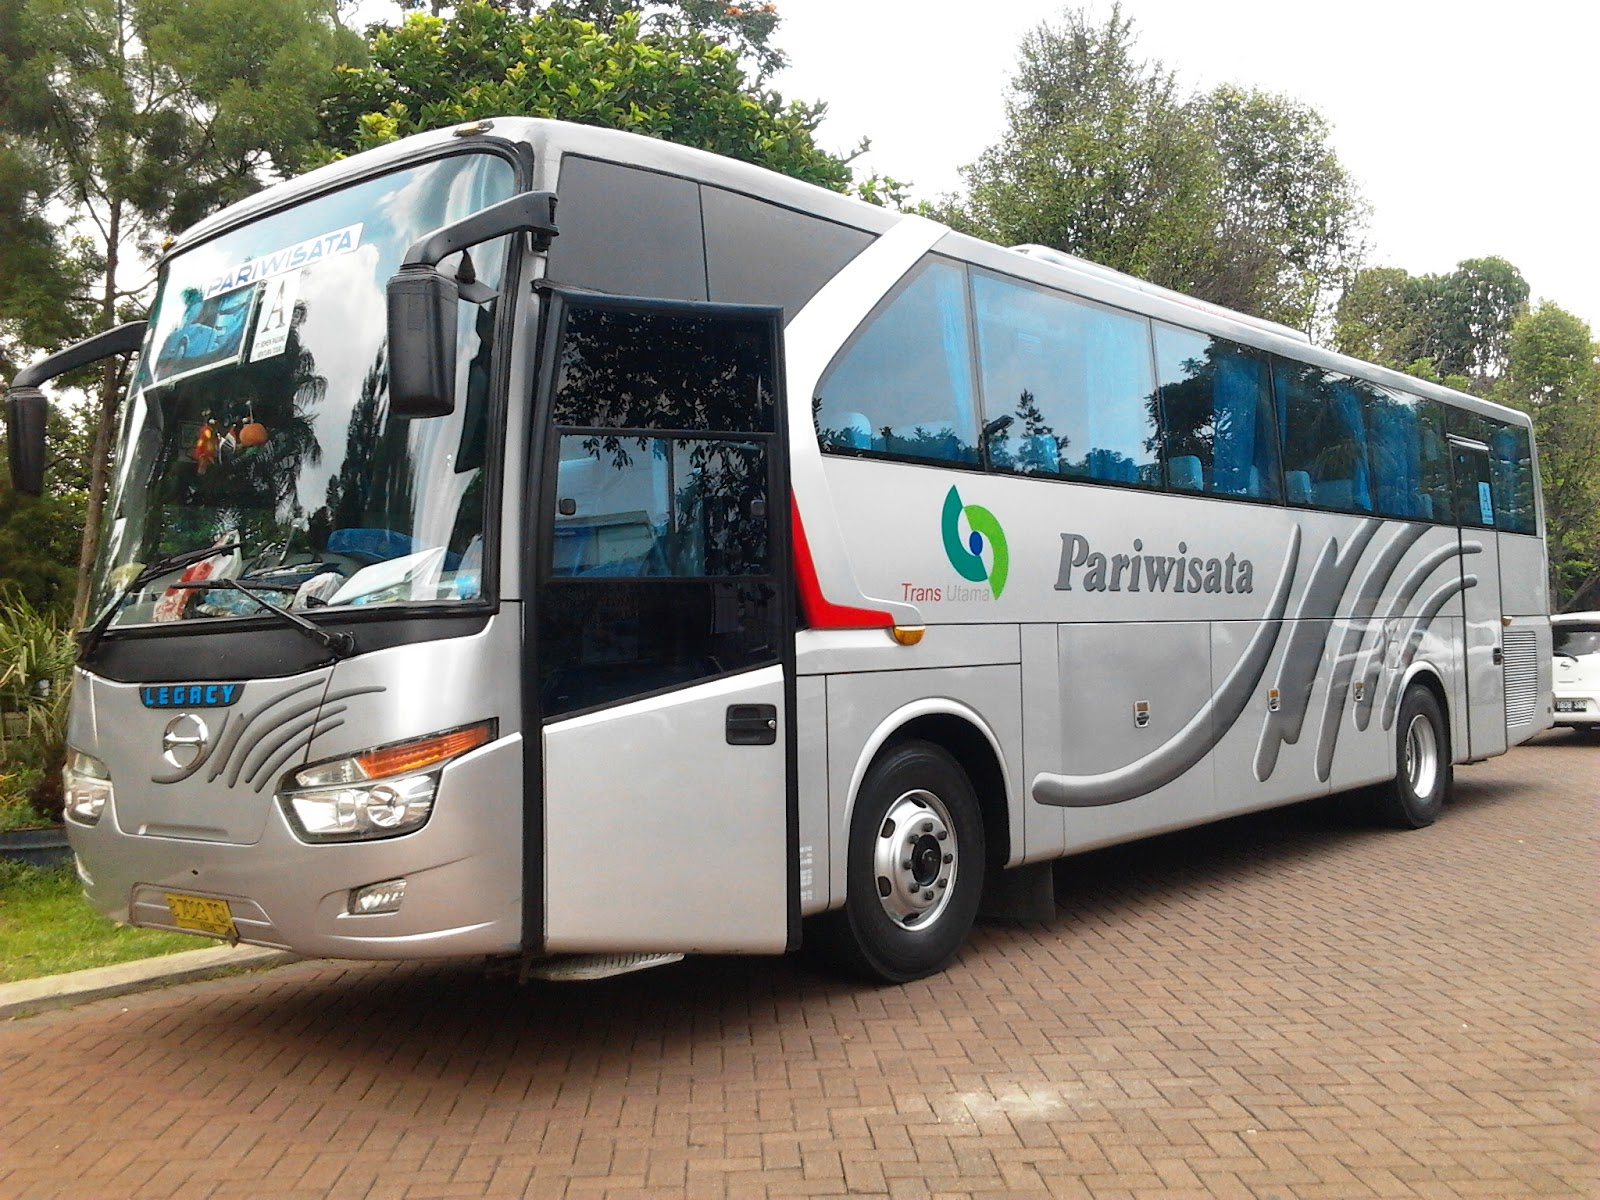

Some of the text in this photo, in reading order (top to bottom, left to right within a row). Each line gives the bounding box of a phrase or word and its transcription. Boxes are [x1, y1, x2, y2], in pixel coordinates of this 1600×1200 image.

[206, 230, 352, 297] PARIWISATA
[261, 279, 286, 333] A
[1054, 532, 1254, 594] Pariwisata
[901, 583, 991, 603] Trans Utama
[144, 685, 235, 706] LEGACY
